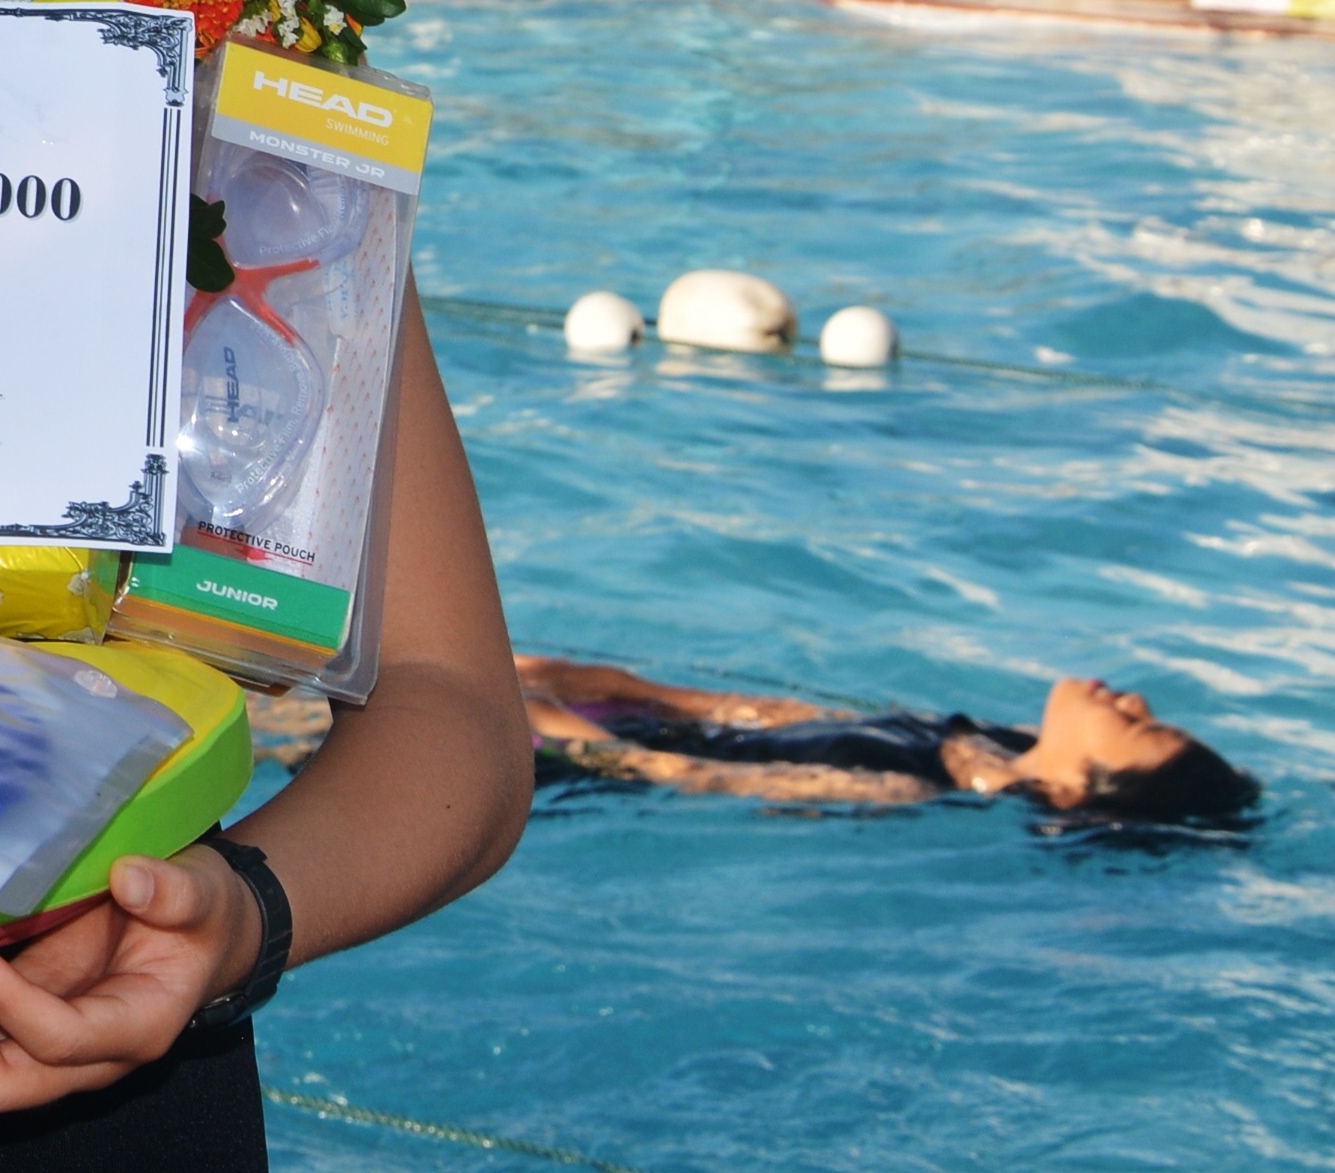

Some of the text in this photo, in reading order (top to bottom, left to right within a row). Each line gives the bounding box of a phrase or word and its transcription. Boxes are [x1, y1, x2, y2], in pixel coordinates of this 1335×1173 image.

[253, 70, 393, 128] HEAD
[249, 130, 386, 179] MONSTER JR
[325, 117, 390, 147] SWIMMING
[223, 346, 240, 423] HEAD
[198, 520, 316, 563] PROTECTIVE POUCH
[196, 580, 279, 611] JUNIOR
